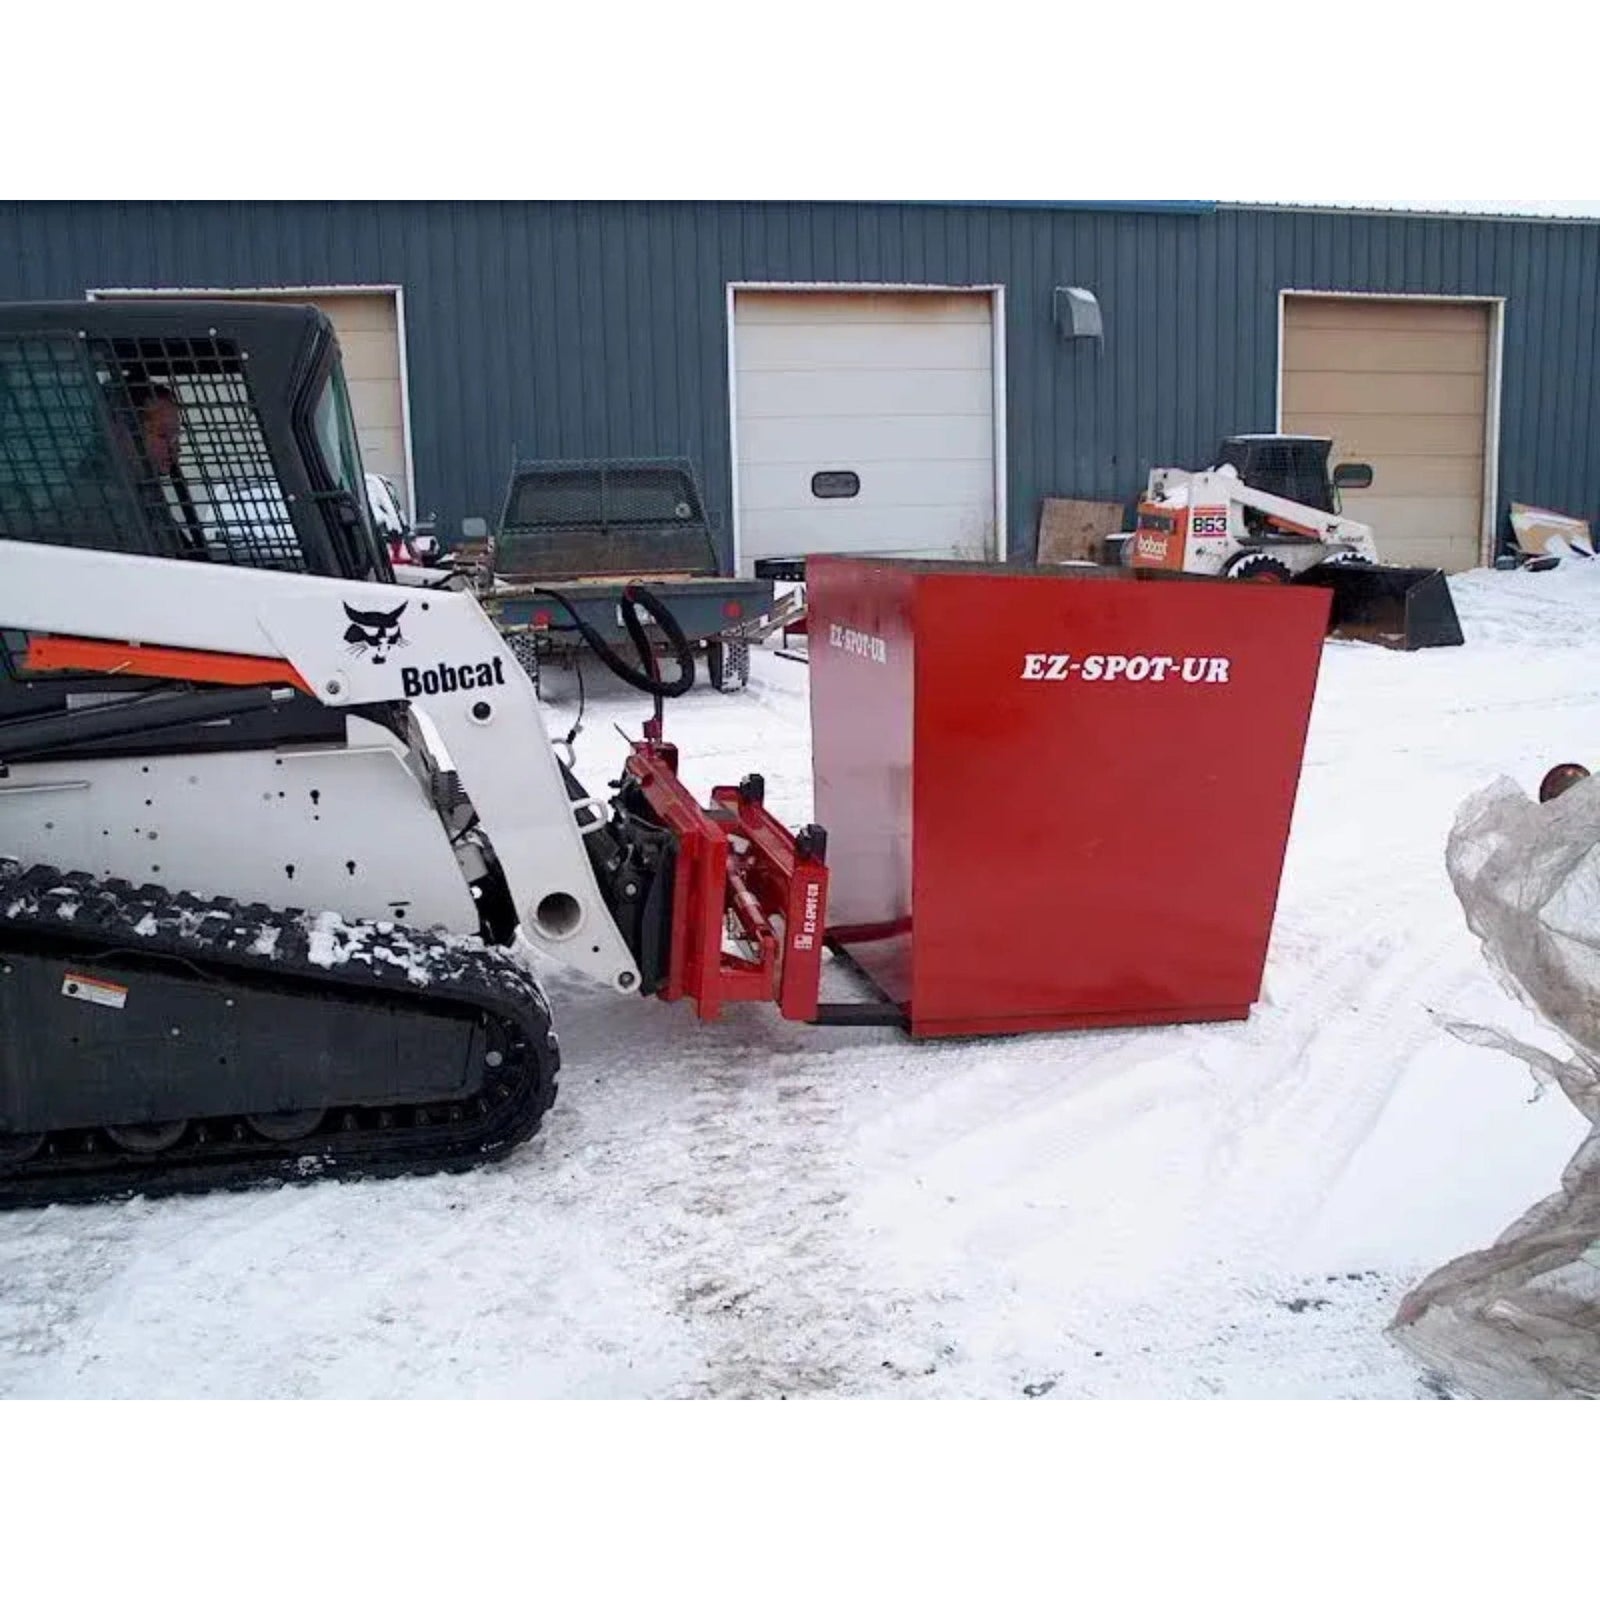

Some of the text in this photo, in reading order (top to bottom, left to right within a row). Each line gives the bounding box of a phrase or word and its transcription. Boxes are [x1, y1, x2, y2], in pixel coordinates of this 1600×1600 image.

[1193, 517, 1227, 532] 863
[401, 656, 505, 697] Bobcat
[1020, 654, 1230, 683] EZ-SPOT-UR
